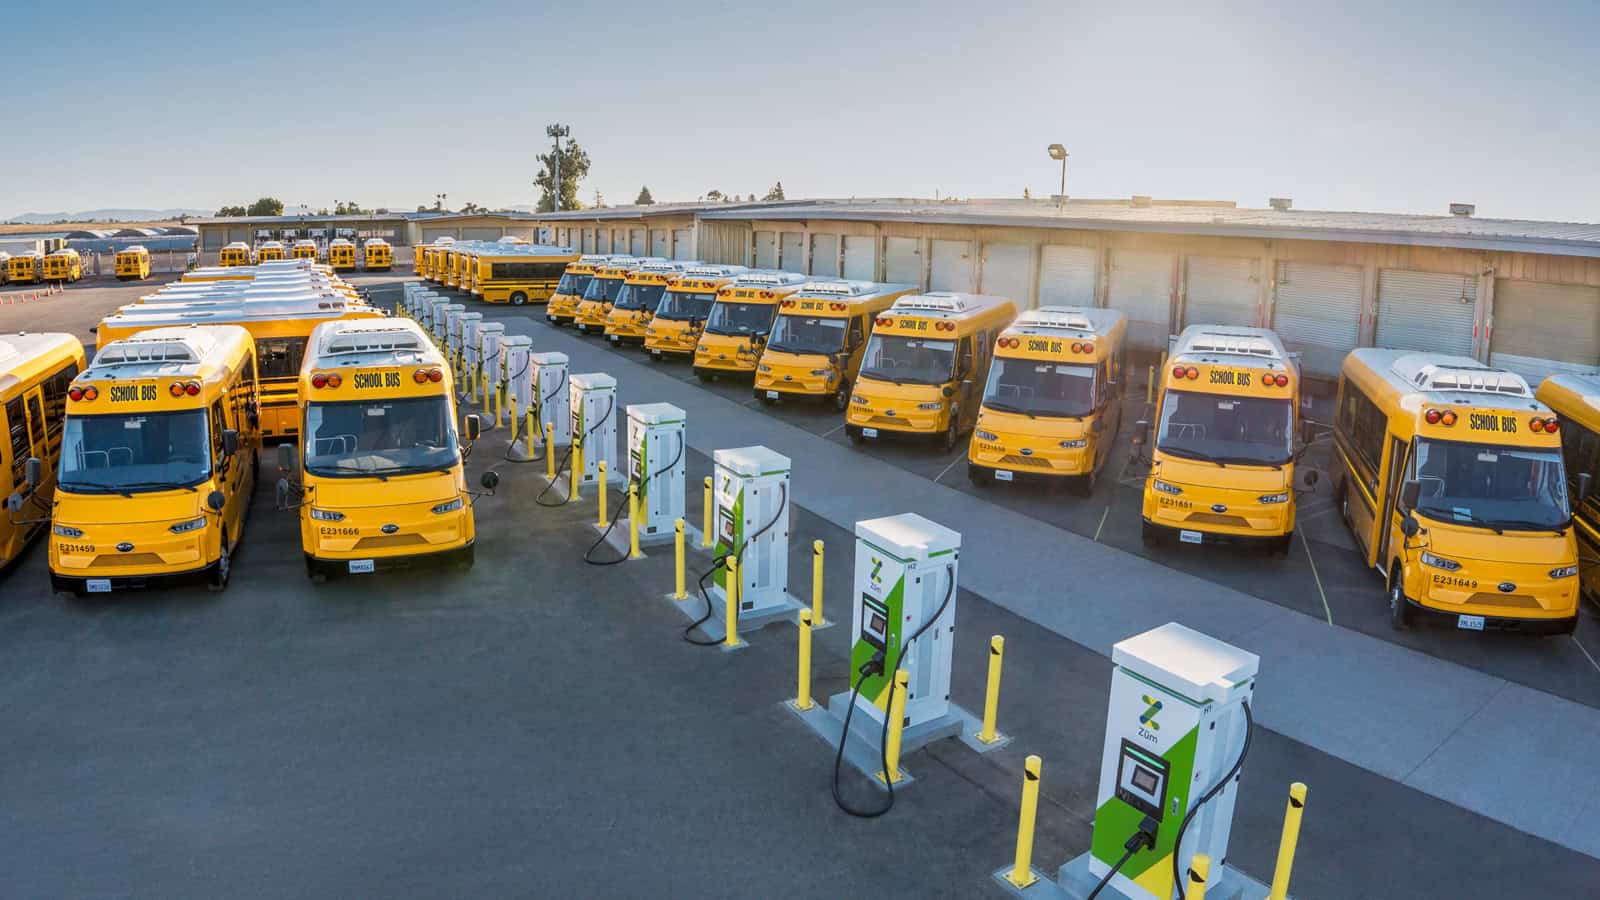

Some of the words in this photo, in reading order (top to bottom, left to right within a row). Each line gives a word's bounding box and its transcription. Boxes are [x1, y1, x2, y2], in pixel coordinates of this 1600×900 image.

[1028, 340, 1048, 352] SCHOOL
[1050, 342, 1062, 353] BUS
[354, 373, 383, 389] SCHOOL
[385, 372, 400, 387] BUS
[1210, 370, 1235, 384] SCHOOL
[1237, 372, 1250, 386] BUS
[111, 386, 139, 402] SCHOOL
[141, 385, 157, 400] BUS
[1469, 413, 1500, 431] SCHOOL
[1502, 416, 1517, 433] BUS
[59, 543, 96, 553] E231459
[1433, 575, 1478, 588] E231649
